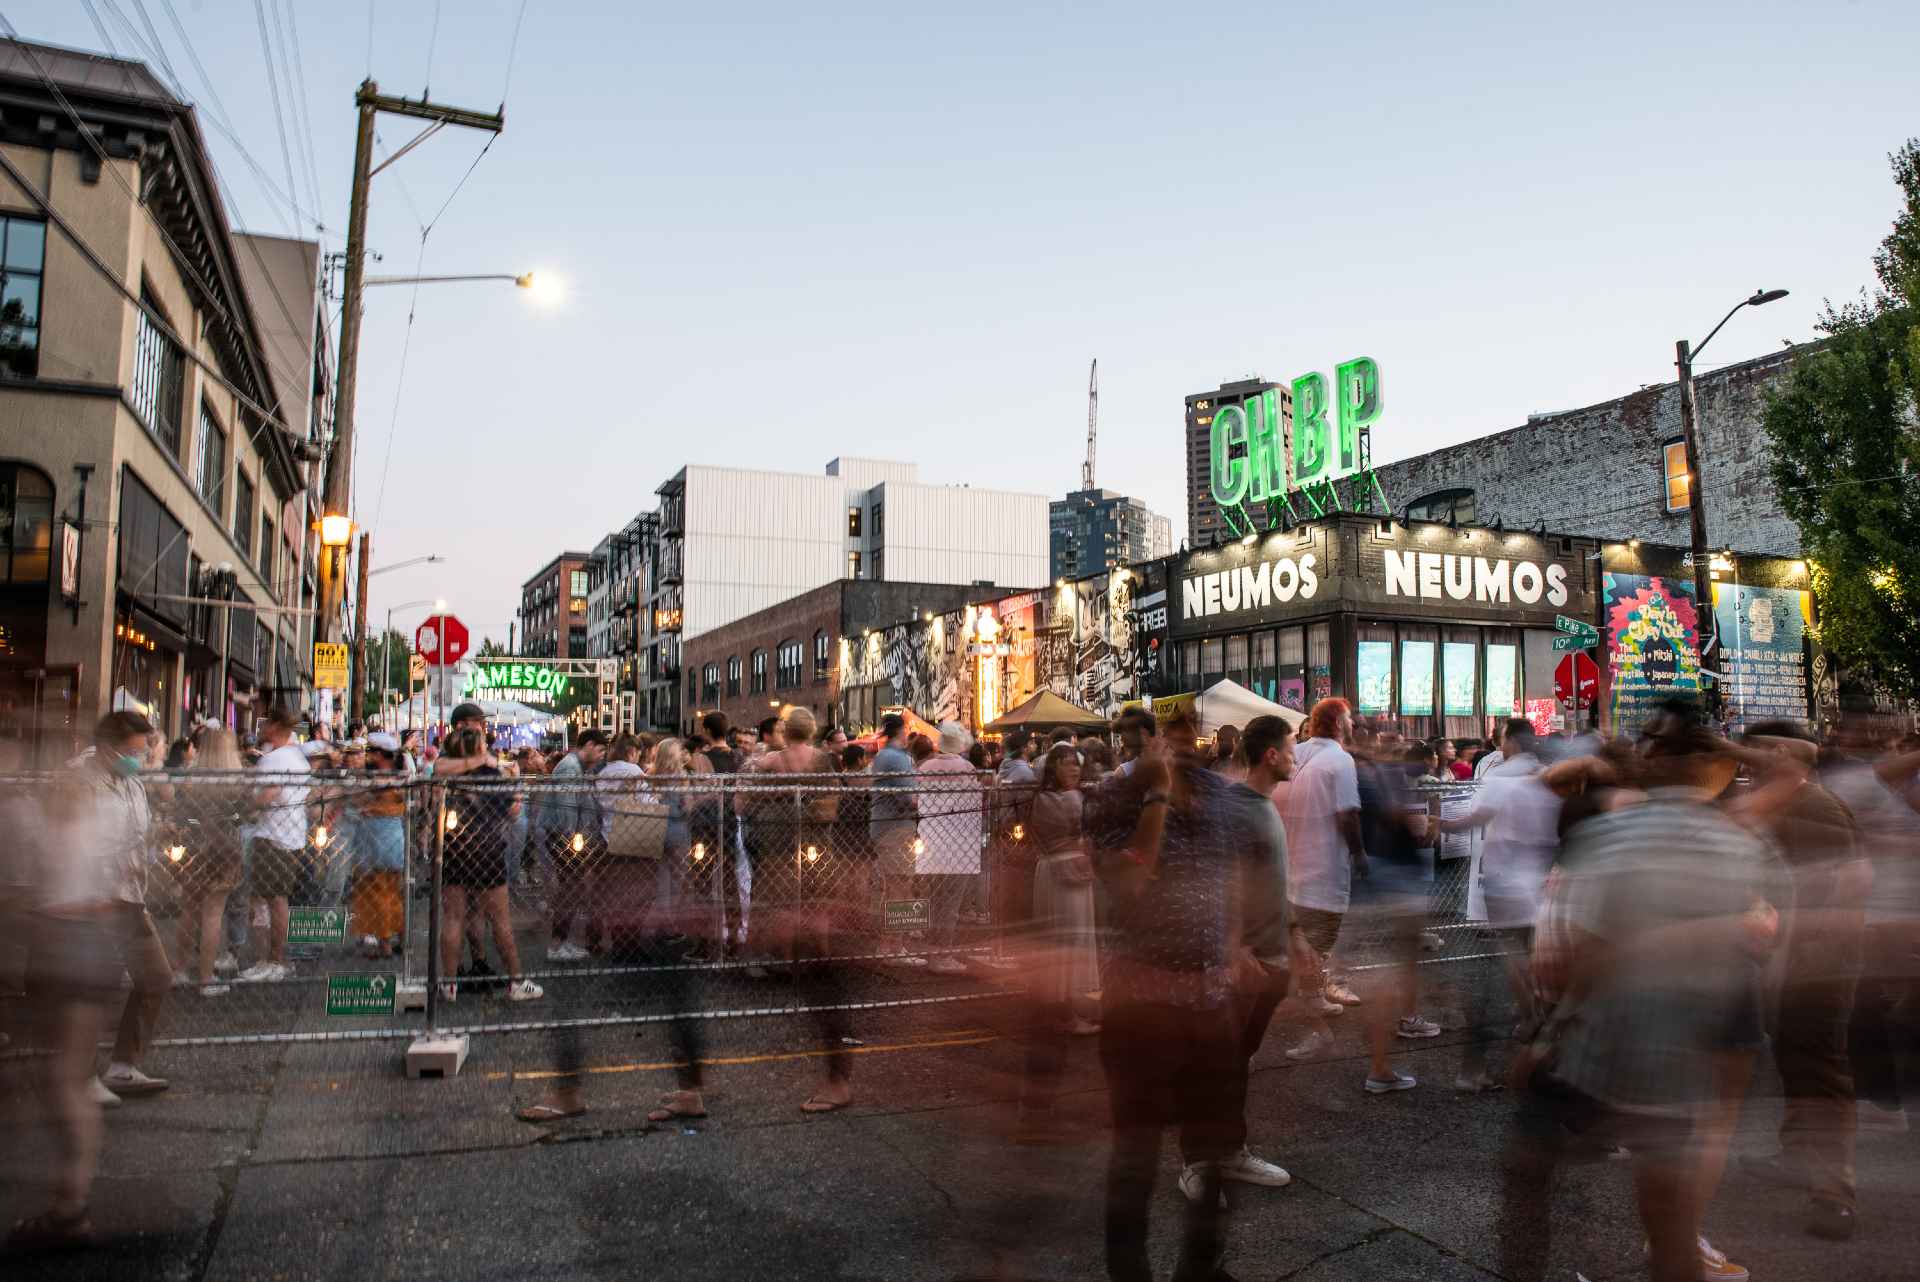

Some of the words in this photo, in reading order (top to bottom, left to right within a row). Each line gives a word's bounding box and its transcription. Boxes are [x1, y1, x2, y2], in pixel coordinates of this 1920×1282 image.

[1211, 356, 1384, 506] CHBP
[1182, 552, 1319, 620] NEUMOS
[1384, 549, 1569, 608] NEUMOS
[1564, 619, 1580, 634] Pike
[464, 665, 566, 695] JAMESON
[473, 687, 502, 702] IRISH
[503, 688, 553, 704] WHISKEY
